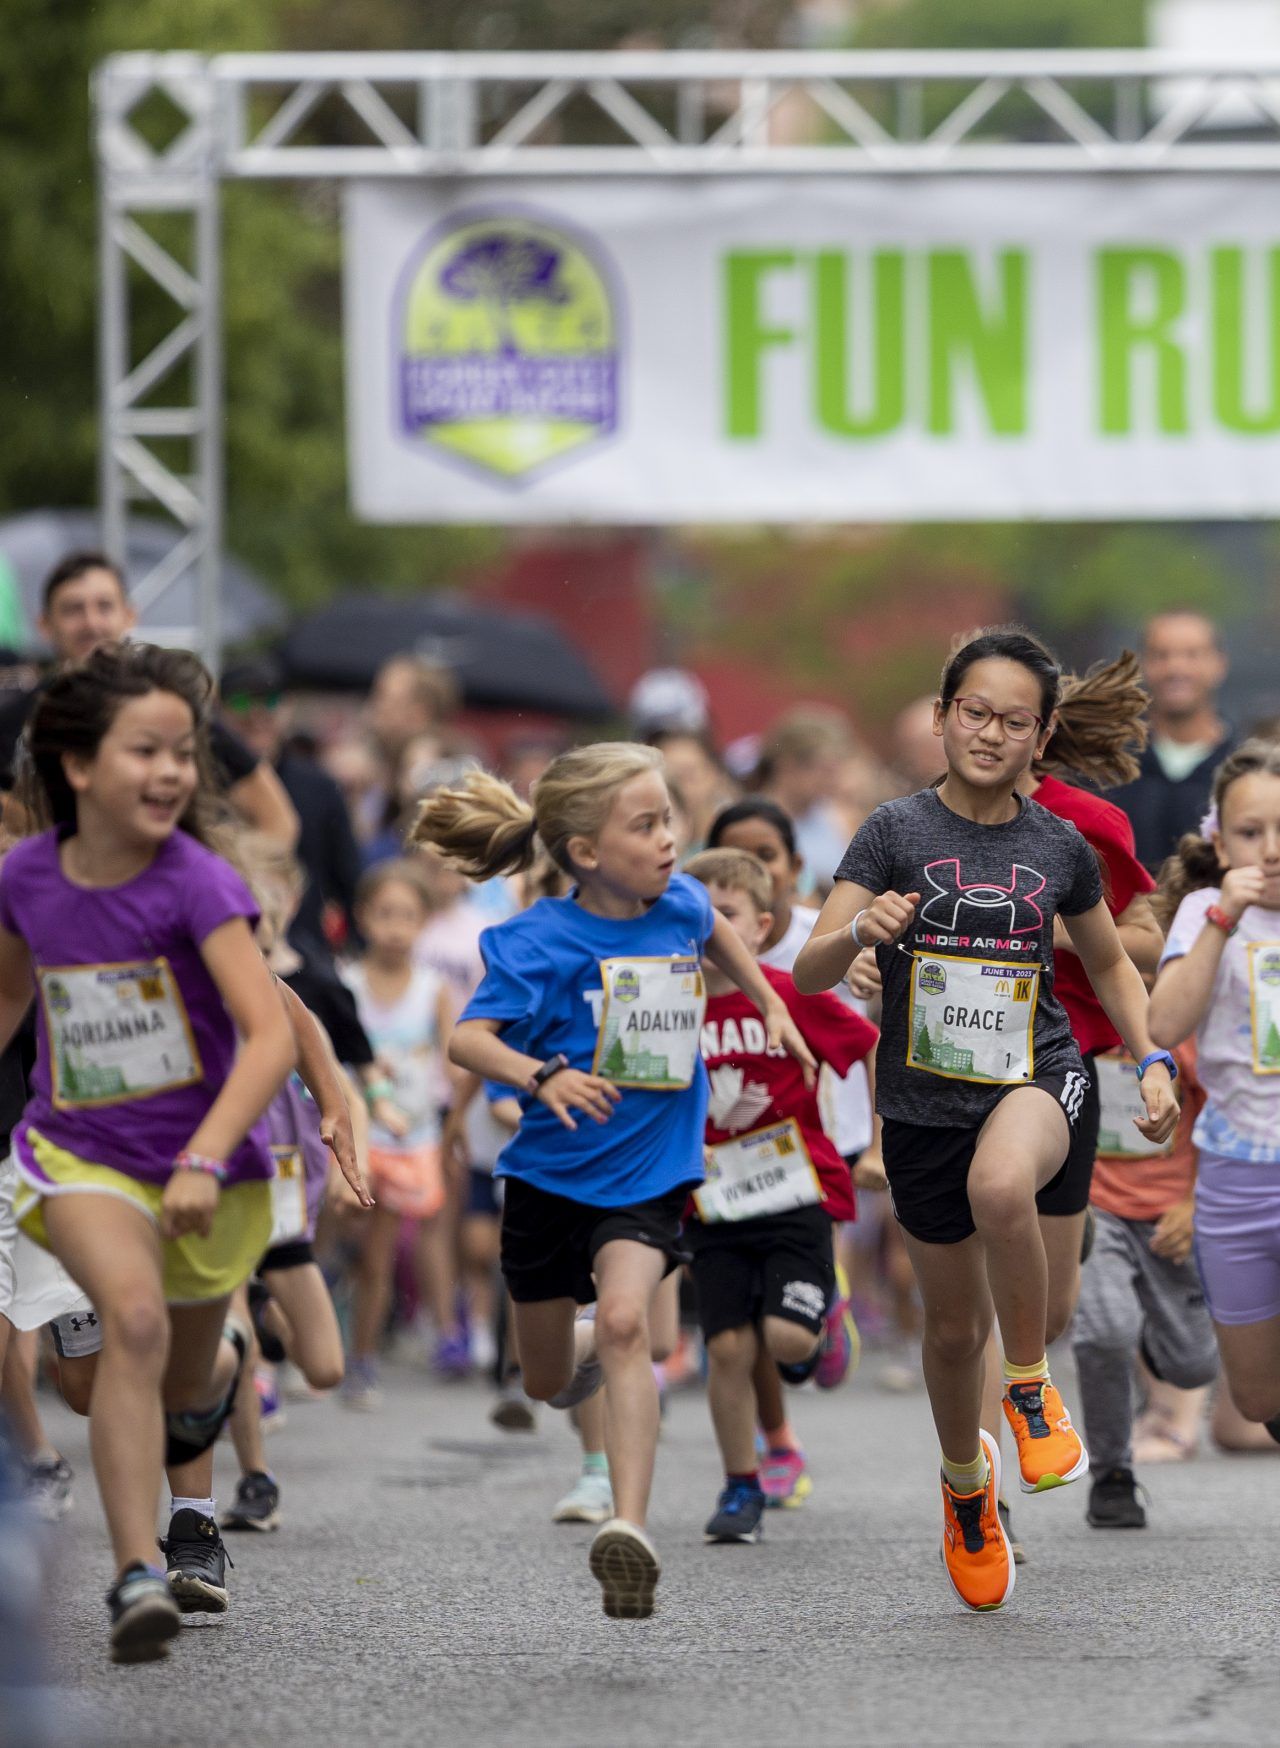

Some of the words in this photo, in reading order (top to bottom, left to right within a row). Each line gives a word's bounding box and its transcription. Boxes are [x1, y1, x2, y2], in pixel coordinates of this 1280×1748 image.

[725, 248, 1028, 440] FUN
[914, 934, 970, 947] UNDER
[972, 937, 1038, 951] ARMOUR
[983, 967, 1004, 976] JUNE
[1006, 969, 1014, 977] 11,
[1015, 970, 1032, 978] 2023
[1017, 980, 1030, 999] 1K
[626, 1009, 696, 1031] ADALYNN
[943, 1005, 1006, 1032] GRACE
[1005, 1052, 1011, 1069] 1
